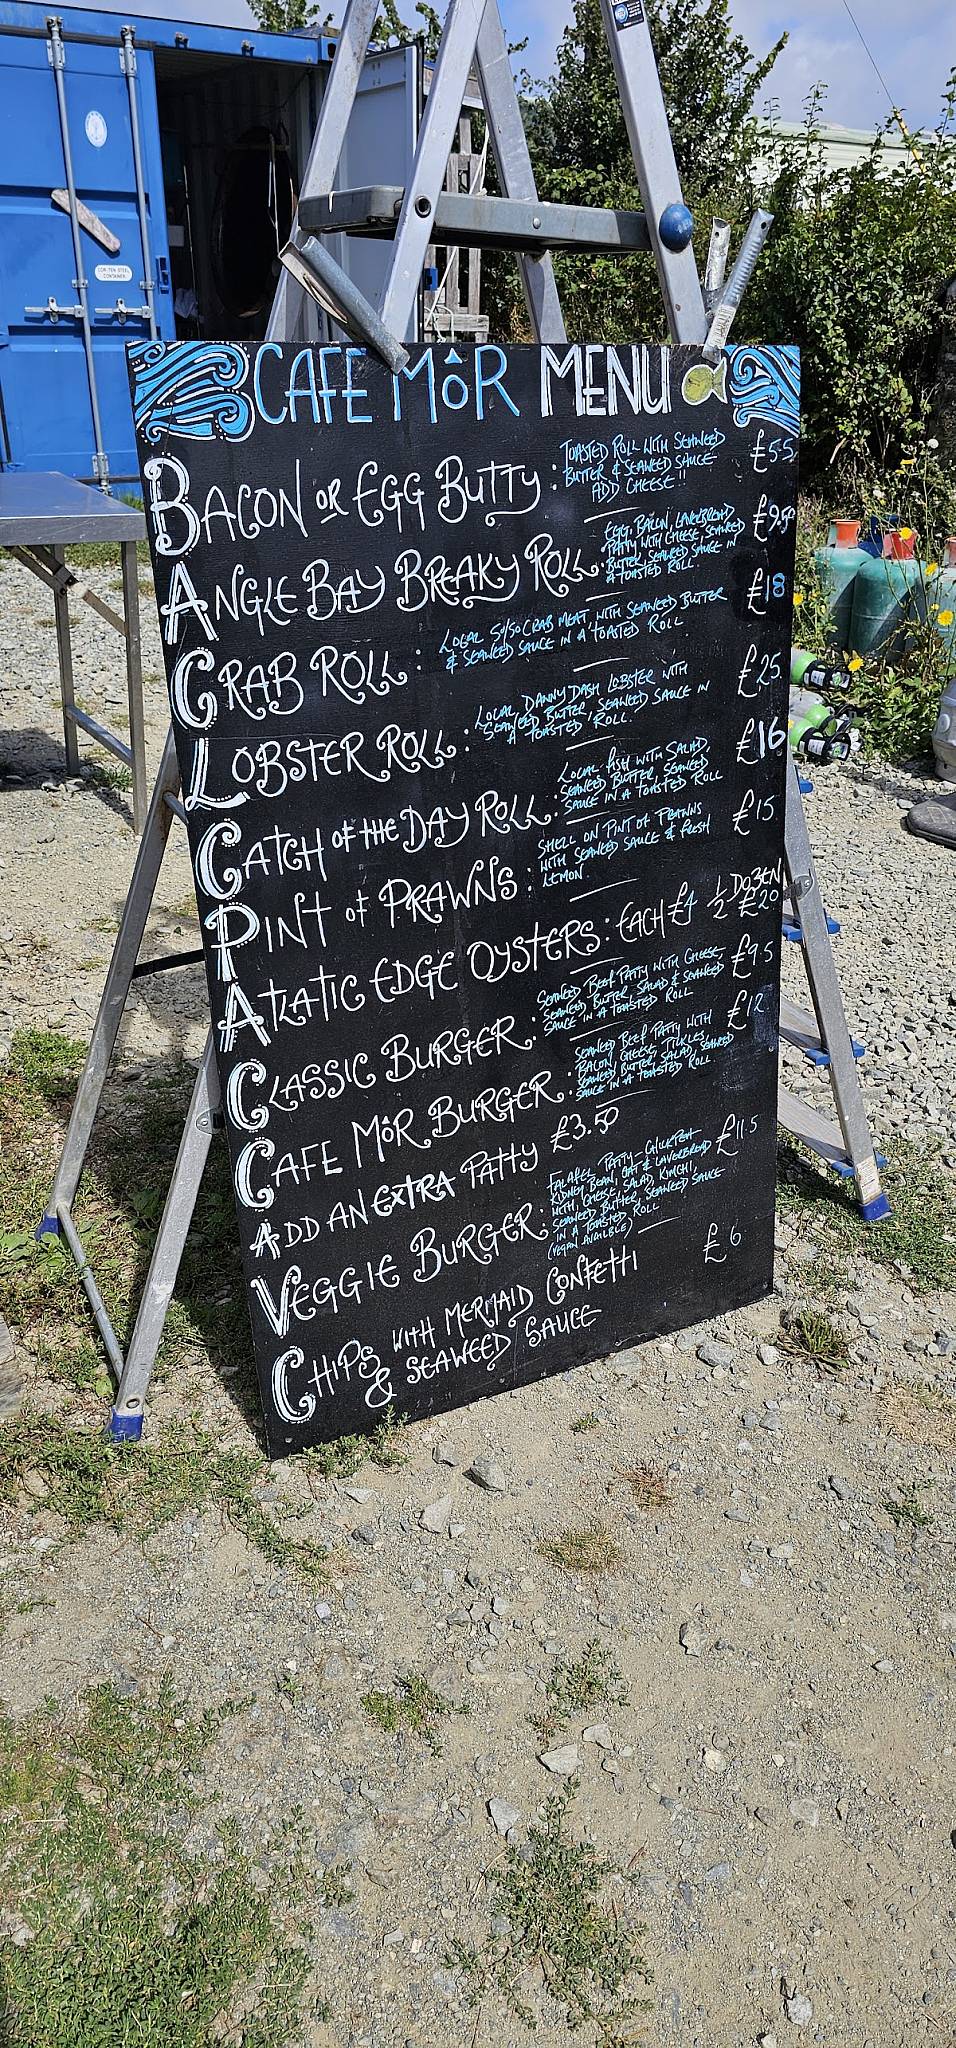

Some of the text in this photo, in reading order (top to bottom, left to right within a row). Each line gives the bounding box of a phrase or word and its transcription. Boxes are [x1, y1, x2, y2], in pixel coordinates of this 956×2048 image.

[253, 343, 373, 424] CAFE
[540, 344, 673, 416] MENU
[559, 427, 726, 468] TOASTED ROLL WITH SEAWEED
[562, 453, 718, 488] BUTTER SEAWEED SAUCE
[143, 452, 309, 557] BACON
[315, 478, 350, 522] OR
[351, 460, 426, 534] EGG
[591, 480, 620, 503] ADD
[641, 533, 663, 549] WITH
[160, 560, 298, 645] ANGLE
[302, 558, 386, 621] BAY
[394, 549, 520, 612] BREAKY
[746, 567, 785, 615] £18
[439, 587, 728, 653] LOCAL CRAB MEAT WITH SEAWEED BUTTER
[463, 643, 514, 667] SEAWEED
[518, 640, 555, 656] SAUCE
[560, 631, 571, 646] IN
[591, 621, 640, 643] TOASTED
[648, 614, 684, 634] ROLL
[171, 646, 304, 730] CRAB
[474, 661, 688, 729] LOCAL DANNY DASH LOBSTER WITH
[598, 690, 649, 714] SEAWEED
[652, 687, 692, 705] SAUCE
[698, 680, 710, 694] IN
[525, 719, 582, 742] TOASTED
[736, 716, 786, 765] £16
[185, 732, 391, 811] LOBSTER
[559, 753, 709, 802] SEAWEED SEAWEED
[635, 746, 663, 766] WITH
[563, 769, 724, 815] SAUCE IN TOASTED ROLL
[732, 788, 775, 836] £15
[196, 818, 328, 900] CATCH
[400, 802, 470, 853] DAY
[537, 802, 702, 859] SHELL ON PINT PRAWNS
[540, 852, 566, 873] WITH
[574, 840, 619, 865] SEAWEED
[623, 831, 661, 851] SAUCE
[738, 886, 779, 917] £20
[204, 890, 332, 982] PINT
[217, 964, 366, 1053] ATLATIC
[369, 951, 459, 1003] EDGE
[615, 898, 666, 943] EACH
[667, 881, 698, 926] £4
[537, 983, 581, 1010] SEAWEED
[616, 963, 649, 985] PATTY
[653, 953, 679, 972] WITH
[542, 1000, 587, 1023] SEAWEED
[636, 977, 669, 995] SALAD
[683, 962, 725, 984] SEAWEED
[543, 987, 694, 1037] SAUCE TOASTED ROLL
[727, 989, 765, 1030] £12
[650, 1020, 681, 1041] PATTY
[686, 1010, 713, 1028] WITH
[226, 1053, 376, 1133] CLASSIC
[575, 1083, 607, 1101] SAUCE
[609, 1078, 620, 1091] IN
[235, 1136, 343, 1212] CAFE
[249, 1106, 619, 1260] ADD AN EXTRA PATTY £3.50
[645, 1177, 689, 1201] SEAWEED
[691, 1168, 726, 1186] SAUCE
[633, 1203, 660, 1218] ROLL
[702, 1222, 742, 1263] £6
[250, 1254, 400, 1338] VEGGIE
[271, 1244, 638, 1424] CHIPS WITH MERMAID CONFETTI
[364, 1304, 602, 1408] & SEAWEED SAUCE
